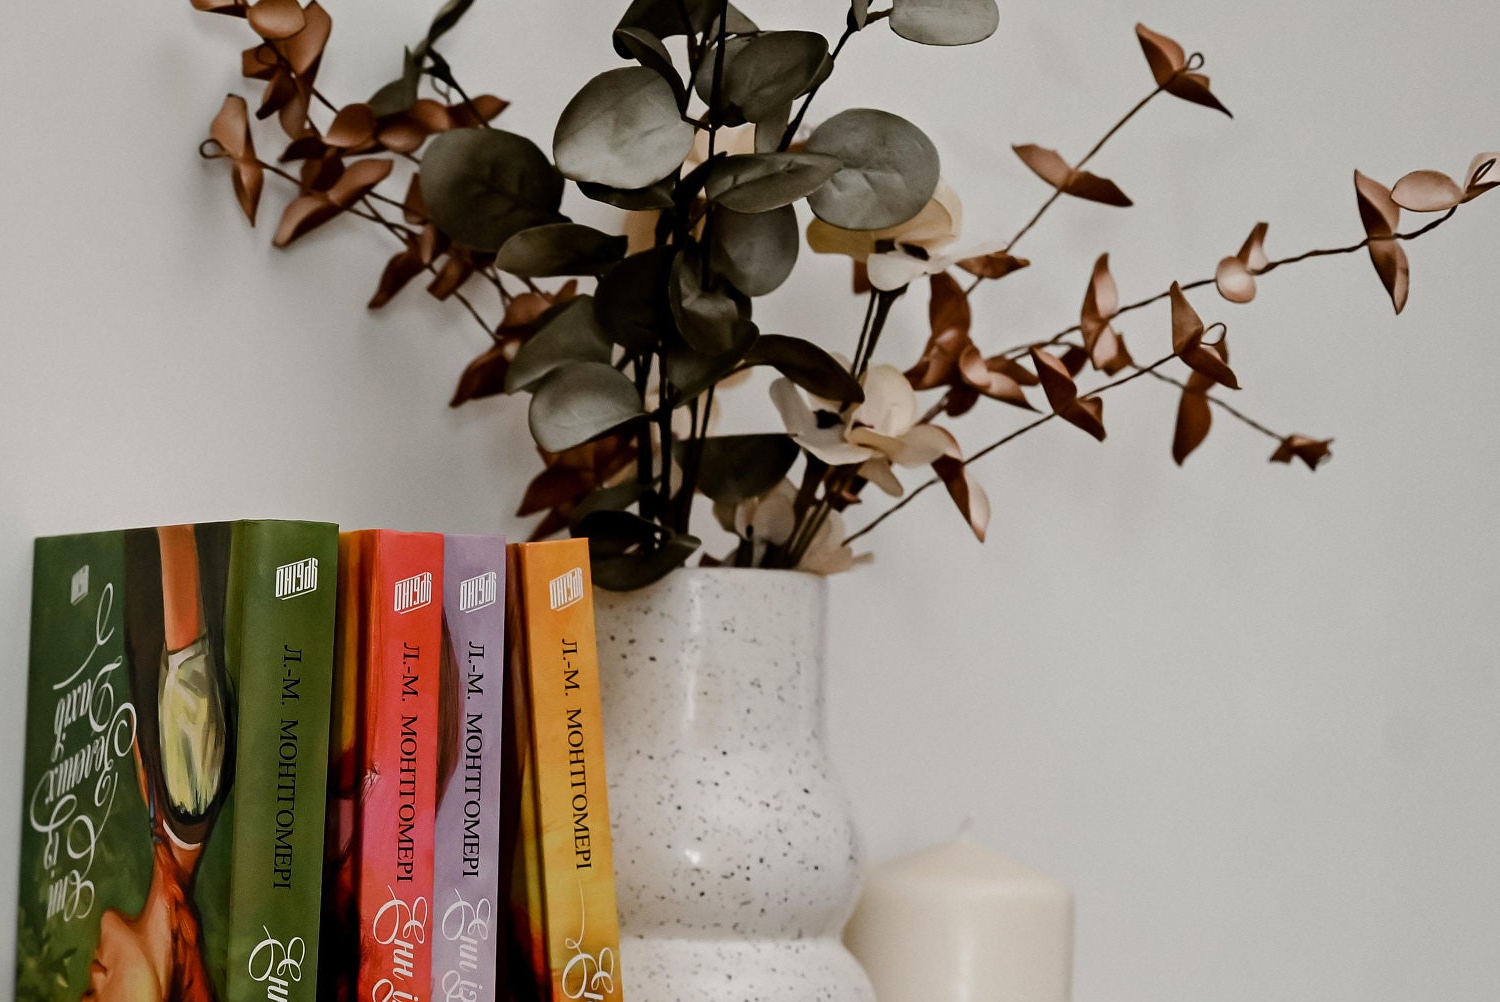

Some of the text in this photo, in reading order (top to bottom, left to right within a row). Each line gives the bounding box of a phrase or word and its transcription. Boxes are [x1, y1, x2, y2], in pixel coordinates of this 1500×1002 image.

[41, 702, 137, 808] Зелених
[273, 644, 303, 890] Л.-М. МОНТГОМЕРІ
[396, 641, 420, 883] Л.-М. МОНТГОМЕРІ
[462, 640, 485, 878] Л.-М. МОНТГОМЕРІ
[561, 638, 593, 870] Л.-М. МОНТГОМЕРІ
[372, 885, 428, 981] Енн
[441, 887, 491, 976] Енн
